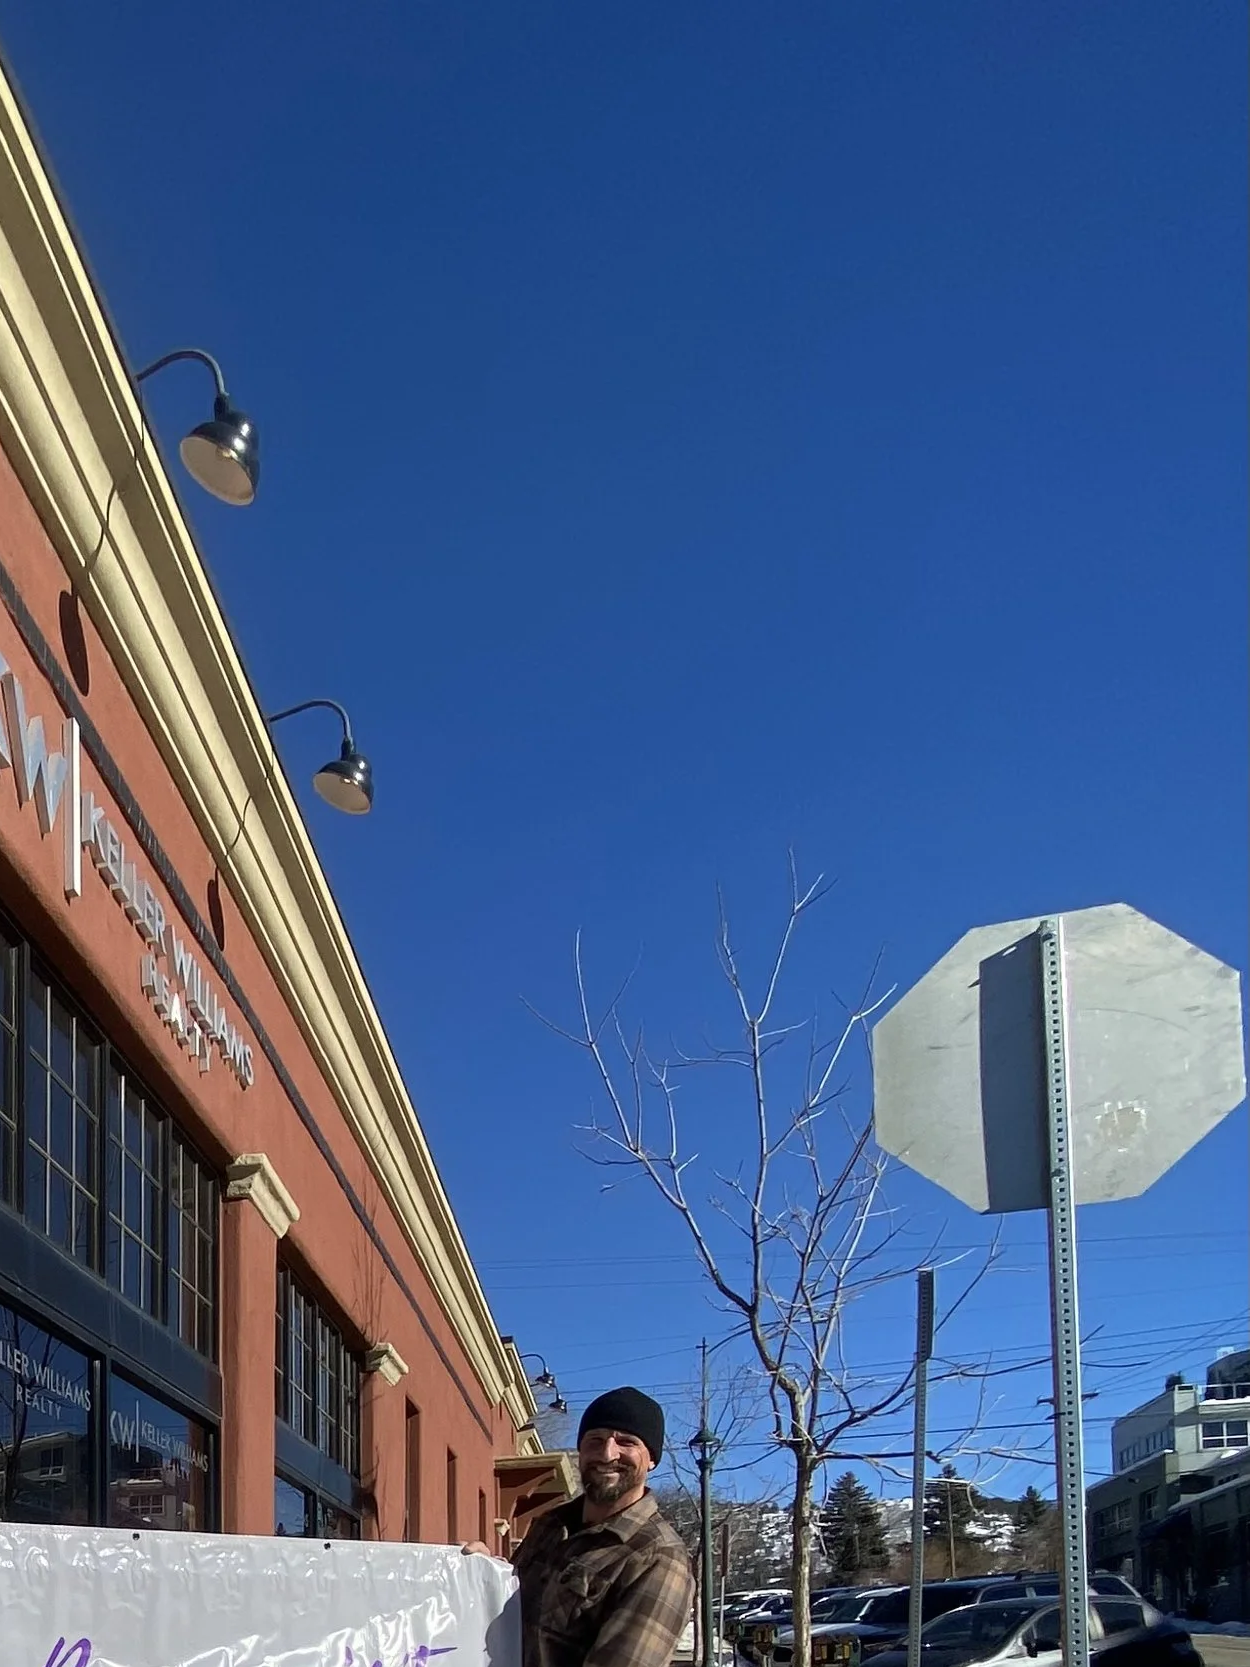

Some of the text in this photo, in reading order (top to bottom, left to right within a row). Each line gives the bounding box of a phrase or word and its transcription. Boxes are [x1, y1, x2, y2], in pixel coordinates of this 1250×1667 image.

[81, 792, 166, 956] KELLER
[165, 924, 254, 1087] WILLIAMS
[141, 954, 211, 1073] REALTY
[16, 1383, 62, 1420] REALTY
[33, 1360, 91, 1411] WILLIAMS
